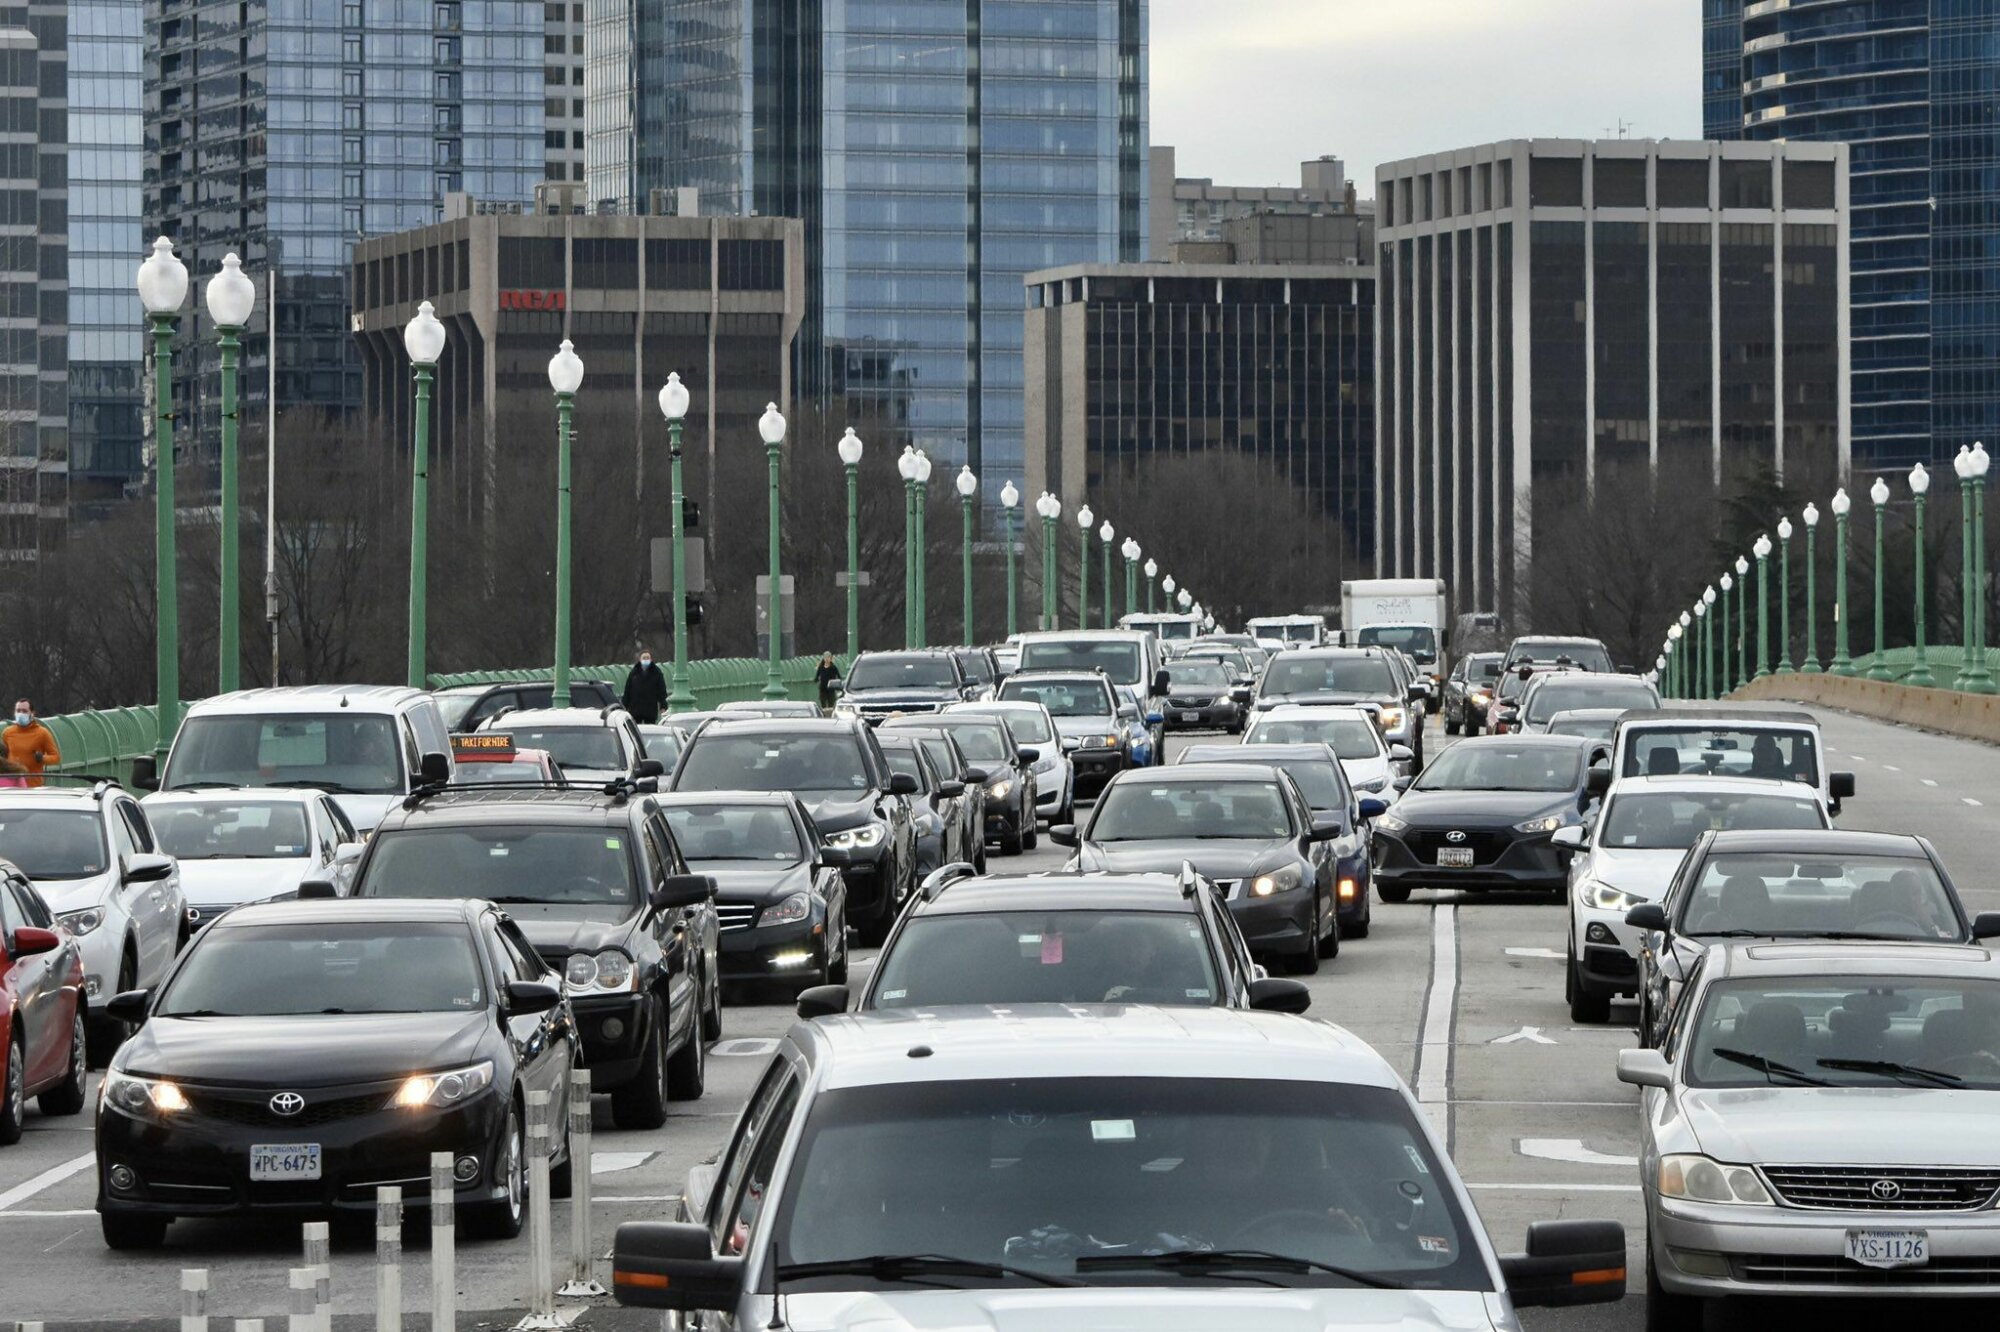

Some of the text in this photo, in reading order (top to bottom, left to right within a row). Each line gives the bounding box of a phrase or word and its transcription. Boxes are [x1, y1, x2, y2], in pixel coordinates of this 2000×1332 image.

[500, 289, 565, 311] RCA
[461, 737, 477, 747] TAXI
[478, 737, 492, 747] FOR
[492, 737, 509, 747] HIRE
[253, 1154, 317, 1172] WPC-6475
[1851, 1239, 1922, 1258] VXS-1126
